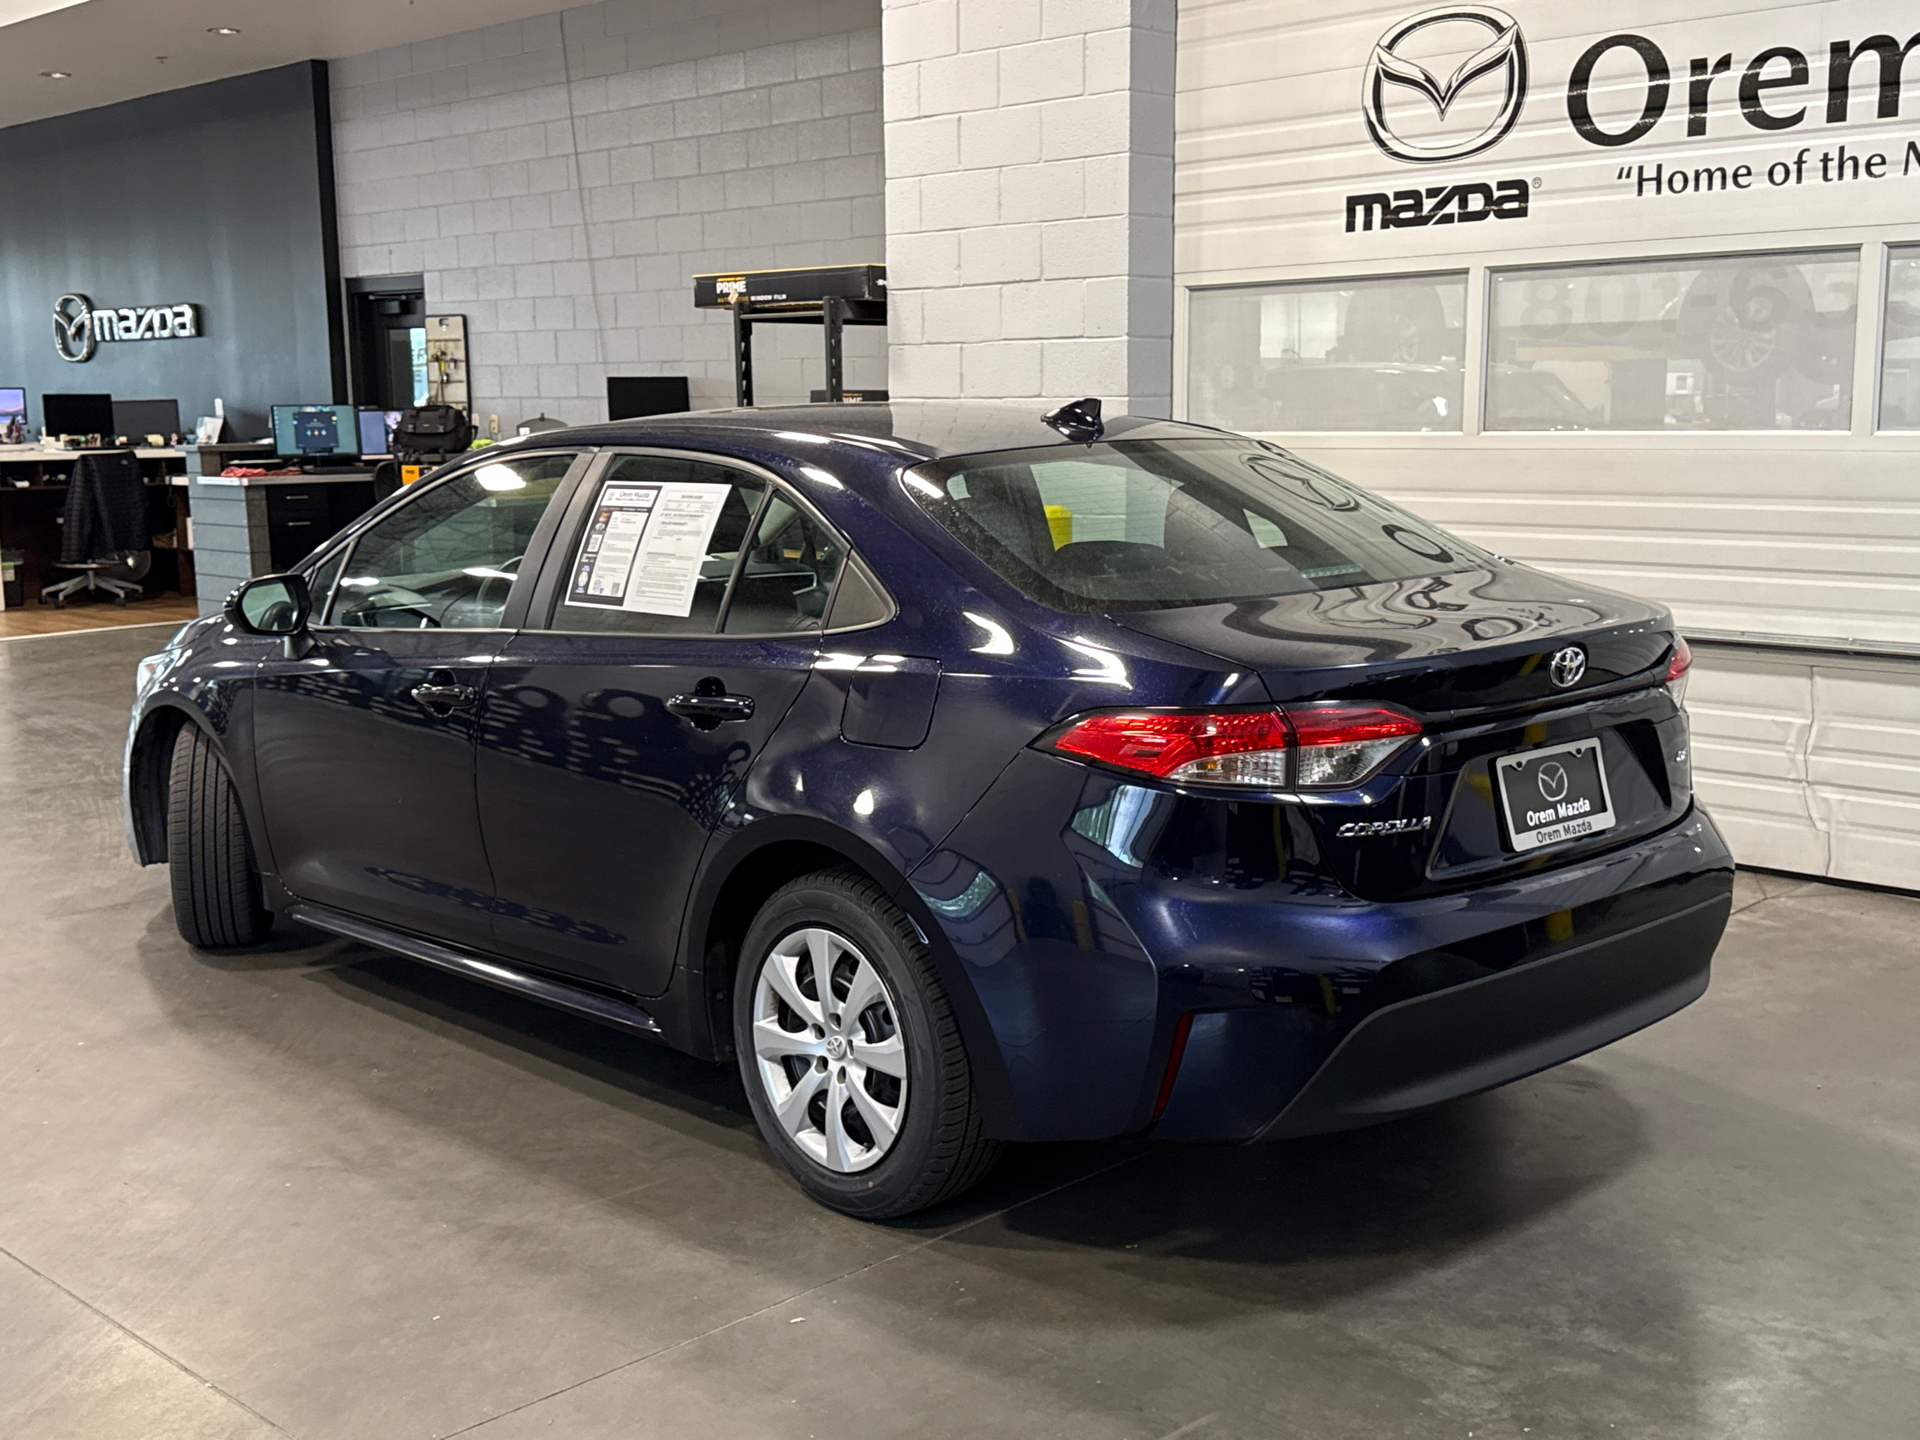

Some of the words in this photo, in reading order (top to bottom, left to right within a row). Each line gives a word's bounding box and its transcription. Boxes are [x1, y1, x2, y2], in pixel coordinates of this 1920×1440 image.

[1567, 32, 1920, 147] Orem
[1616, 163, 1752, 197] “Home
[1767, 148, 1810, 186] of
[1819, 145, 1887, 182] the
[716, 280, 747, 294] PRIME
[1526, 808, 1556, 827] Orem
[1556, 797, 1591, 818] Mazda
[1336, 816, 1432, 837] COROLLA
[1536, 829, 1562, 843] Orem
[1562, 820, 1593, 837] Mazda
